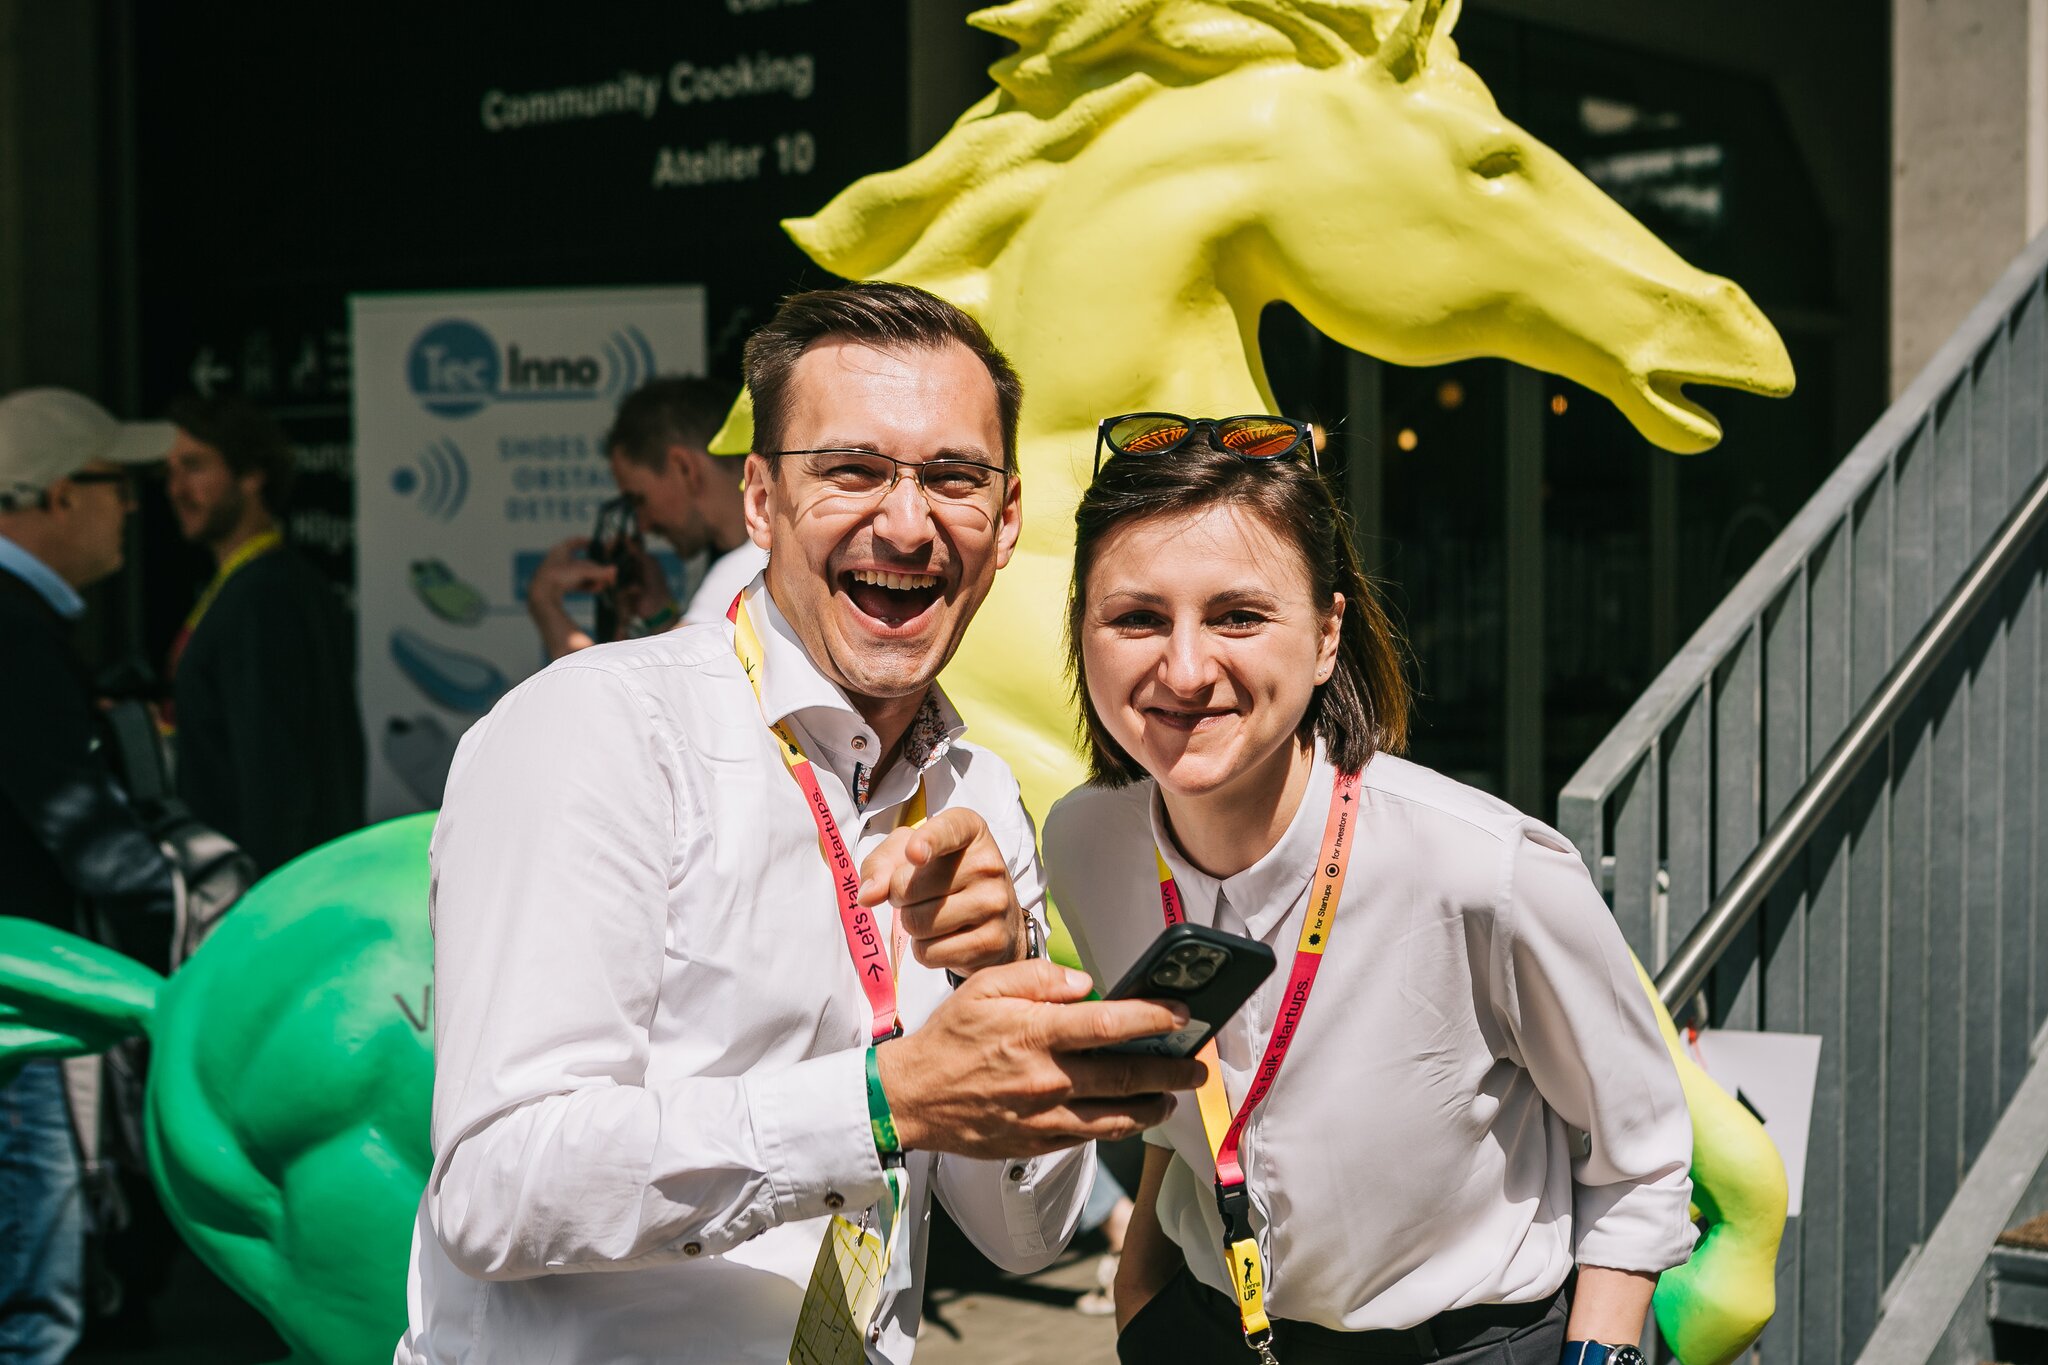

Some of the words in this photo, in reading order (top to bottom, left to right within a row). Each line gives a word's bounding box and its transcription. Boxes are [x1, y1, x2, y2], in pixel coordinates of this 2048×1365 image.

[481, 70, 661, 132] Community
[669, 52, 815, 103] Cooking
[653, 138, 765, 189] Atelier
[776, 132, 816, 174] 10
[424, 345, 490, 395] Tec
[507, 343, 600, 386] Inno
[499, 435, 588, 460] SHOES
[812, 787, 849, 869] startups.
[1334, 811, 1348, 848] Investors
[1332, 848, 1340, 860] for
[842, 873, 859, 910] talk
[1163, 887, 1177, 925] vien
[1317, 884, 1332, 918] Startups
[853, 912, 879, 959] Let's
[1314, 918, 1323, 930] for
[1259, 1053, 1282, 1084] talk
[1275, 977, 1310, 1049] startups.
[1242, 1281, 1261, 1291] Vienna
[1243, 1289, 1257, 1301] UP
